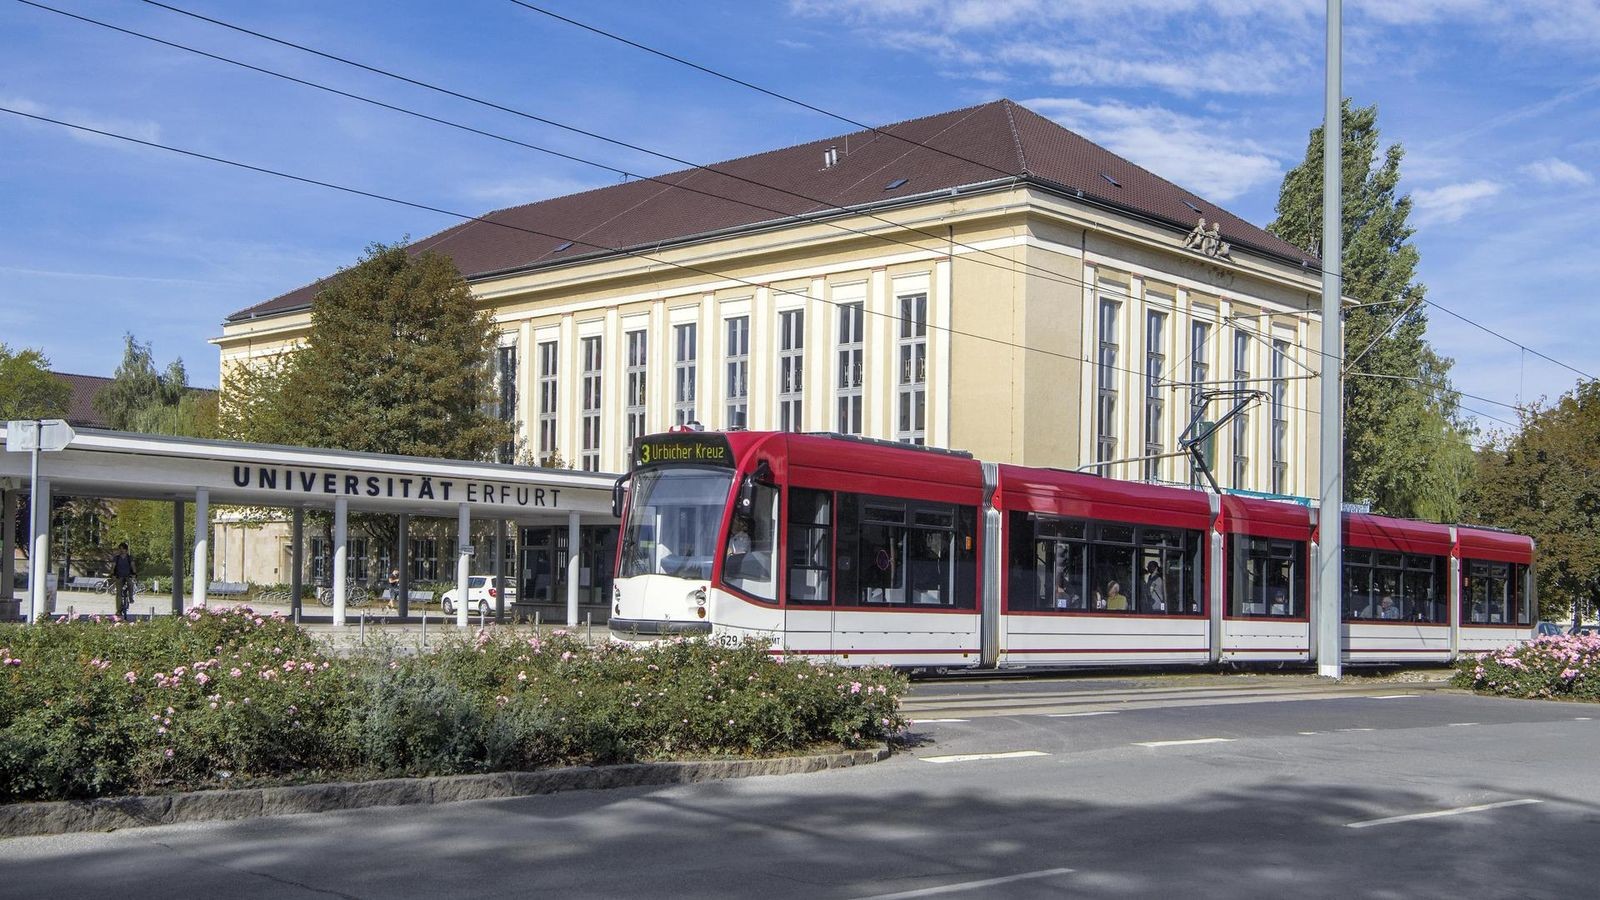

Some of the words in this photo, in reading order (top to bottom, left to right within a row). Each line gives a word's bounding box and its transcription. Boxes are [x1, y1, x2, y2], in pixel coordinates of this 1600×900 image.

[641, 444, 650, 463] 3
[652, 443, 693, 460] Urbicher
[695, 443, 724, 459] Kreuz
[233, 466, 453, 501] UNIVERSITÄT
[467, 483, 561, 508] ERFURT
[720, 635, 738, 646] 629
